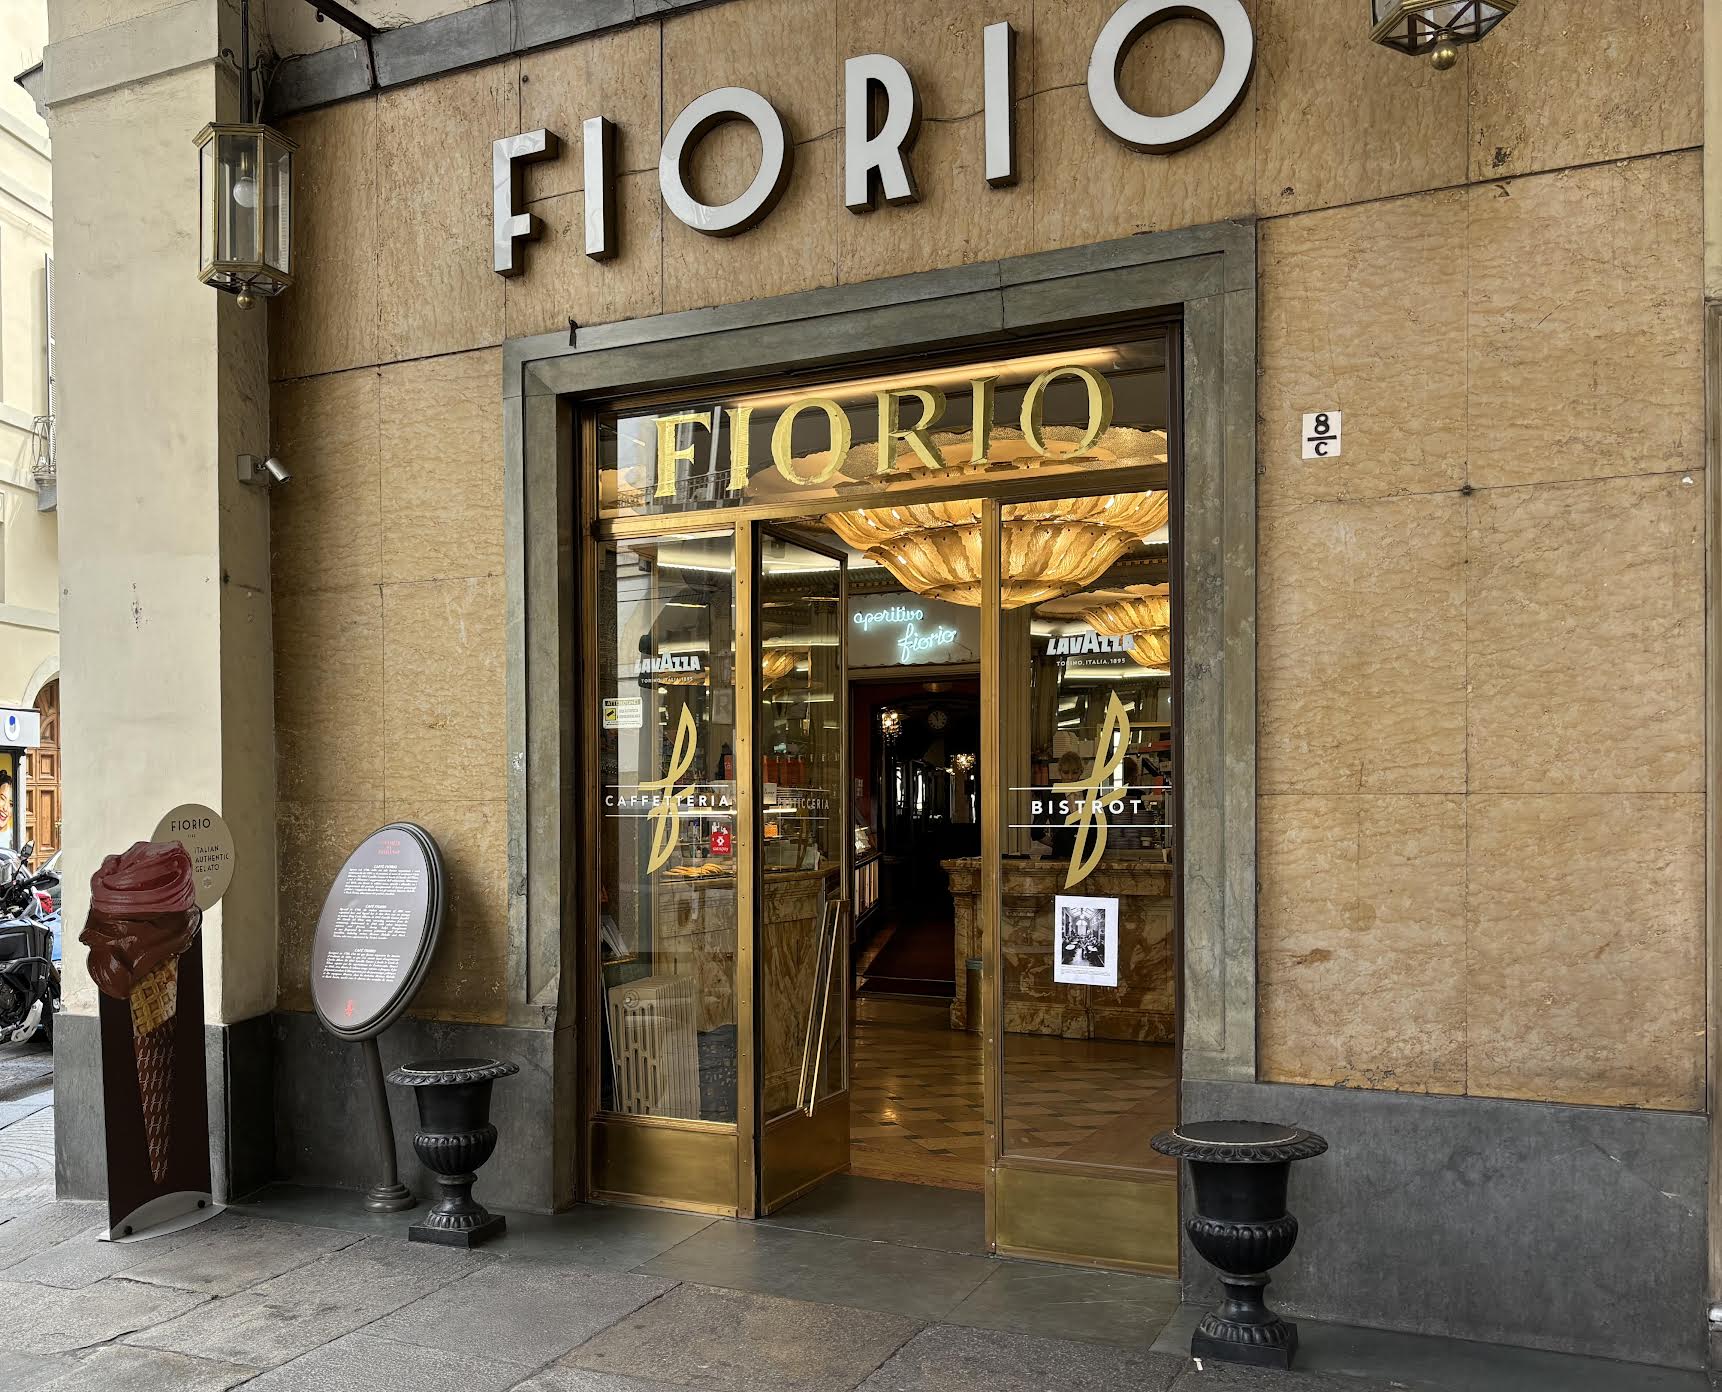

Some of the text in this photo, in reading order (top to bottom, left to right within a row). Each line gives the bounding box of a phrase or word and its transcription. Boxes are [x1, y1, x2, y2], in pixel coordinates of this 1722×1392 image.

[493, 0, 1255, 277] FIORIO
[654, 364, 1114, 498] FIORIO
[1314, 413, 1330, 435] 8
[853, 605, 924, 632] aperitivo
[897, 622, 956, 662] fiorio
[1046, 630, 1135, 655] LAVAZZA
[634, 651, 701, 674] LAVAZZA
[605, 795, 729, 807] CAFFETTERIA
[1031, 799, 1142, 815] BISTROT
[171, 818, 211, 832] FIORIO
[195, 844, 219, 854] ITALIAN
[195, 853, 230, 864] AUTHENTIC
[195, 863, 220, 873] GELATO
